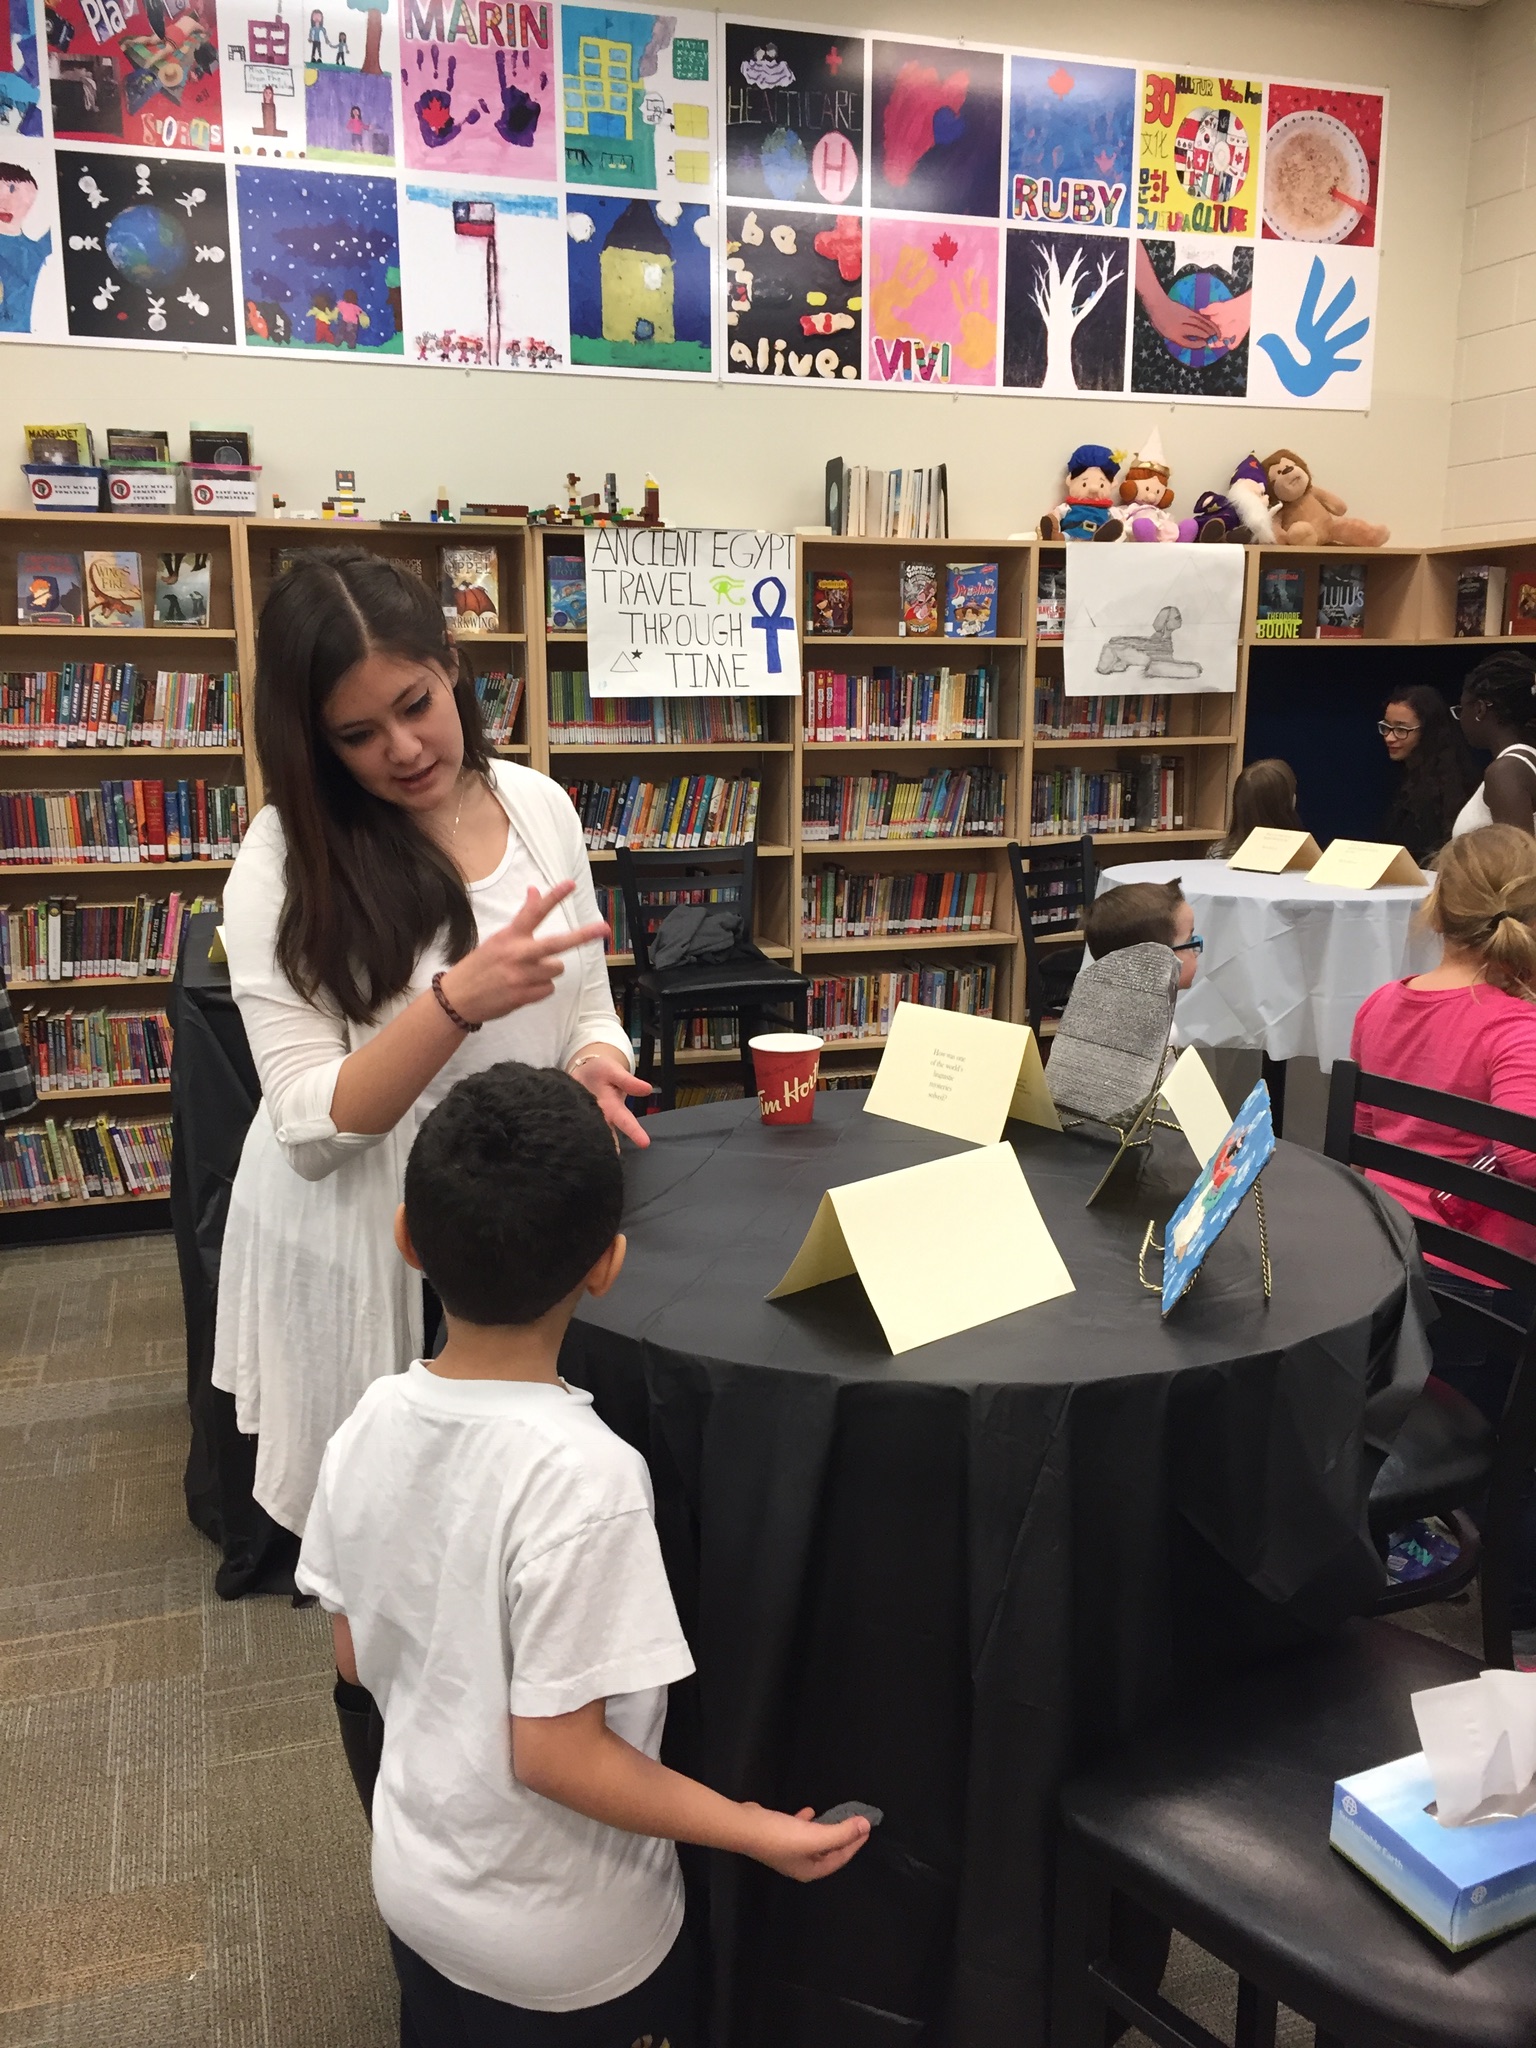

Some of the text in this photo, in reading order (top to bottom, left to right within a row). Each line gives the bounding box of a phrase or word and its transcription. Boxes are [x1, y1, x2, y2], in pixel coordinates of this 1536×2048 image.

[80, 0, 136, 45] Play
[404, 0, 549, 49] MARIN
[1144, 74, 1176, 128] 30
[1176, 74, 1213, 97] KULTUR
[1140, 130, 1169, 160] 文化
[821, 141, 846, 192] H
[1013, 176, 1124, 226] RUBY
[730, 337, 857, 379] alive.
[871, 337, 951, 382] VIVI
[28, 429, 78, 439] MARGARET
[592, 527, 796, 570] ANCIENT EGYPT
[101, 577, 126, 589] FIRE
[444, 561, 493, 575] OPPEL
[591, 569, 707, 607] TRAVEL
[618, 611, 743, 647] THROUGH
[1257, 622, 1300, 639] BOONE
[1267, 611, 1301, 621] THEODORE
[665, 653, 750, 688] TIME
[758, 1058, 820, 1118] Tim Hort
